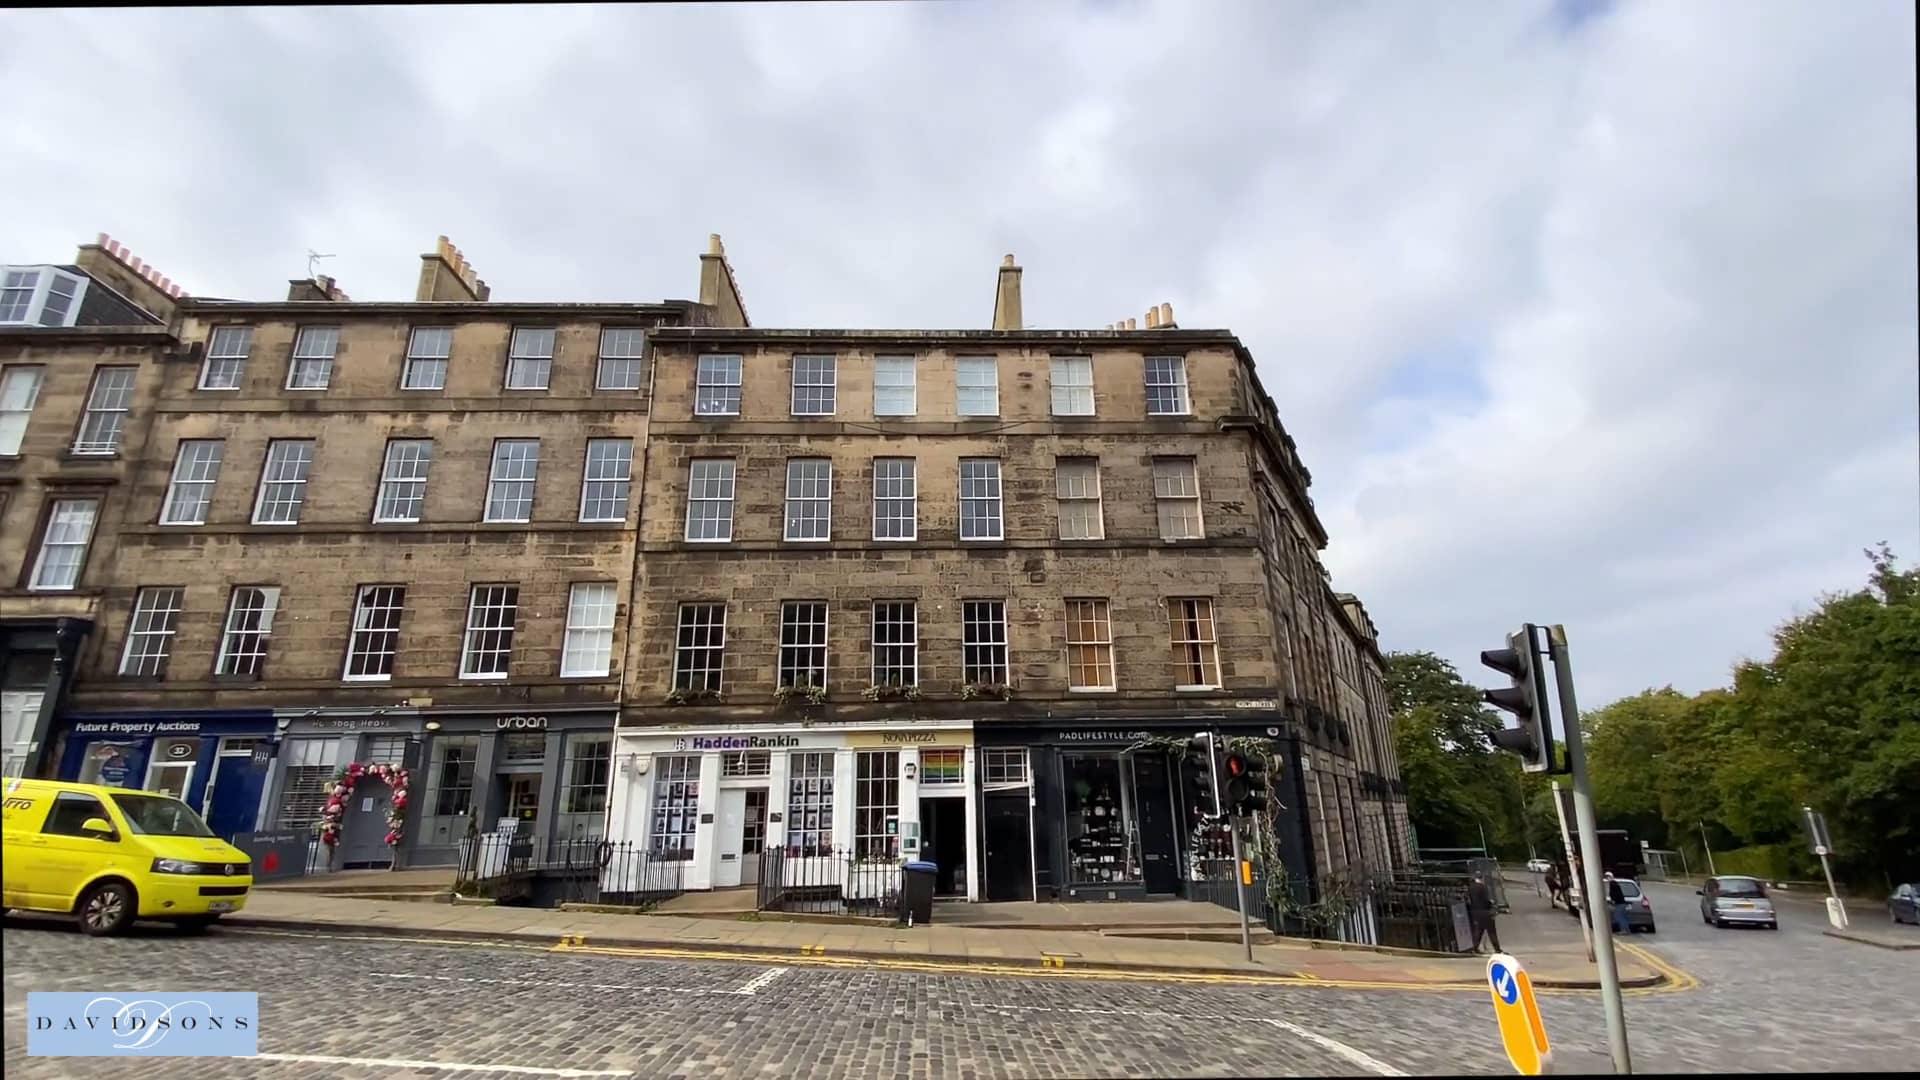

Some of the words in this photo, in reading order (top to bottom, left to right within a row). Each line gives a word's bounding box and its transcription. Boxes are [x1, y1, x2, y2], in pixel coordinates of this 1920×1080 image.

[75, 722, 109, 732] Future
[110, 722, 156, 733] Property
[157, 721, 200, 731] Auctions
[497, 716, 548, 728] urban
[693, 735, 800, 749] HaddenRankin
